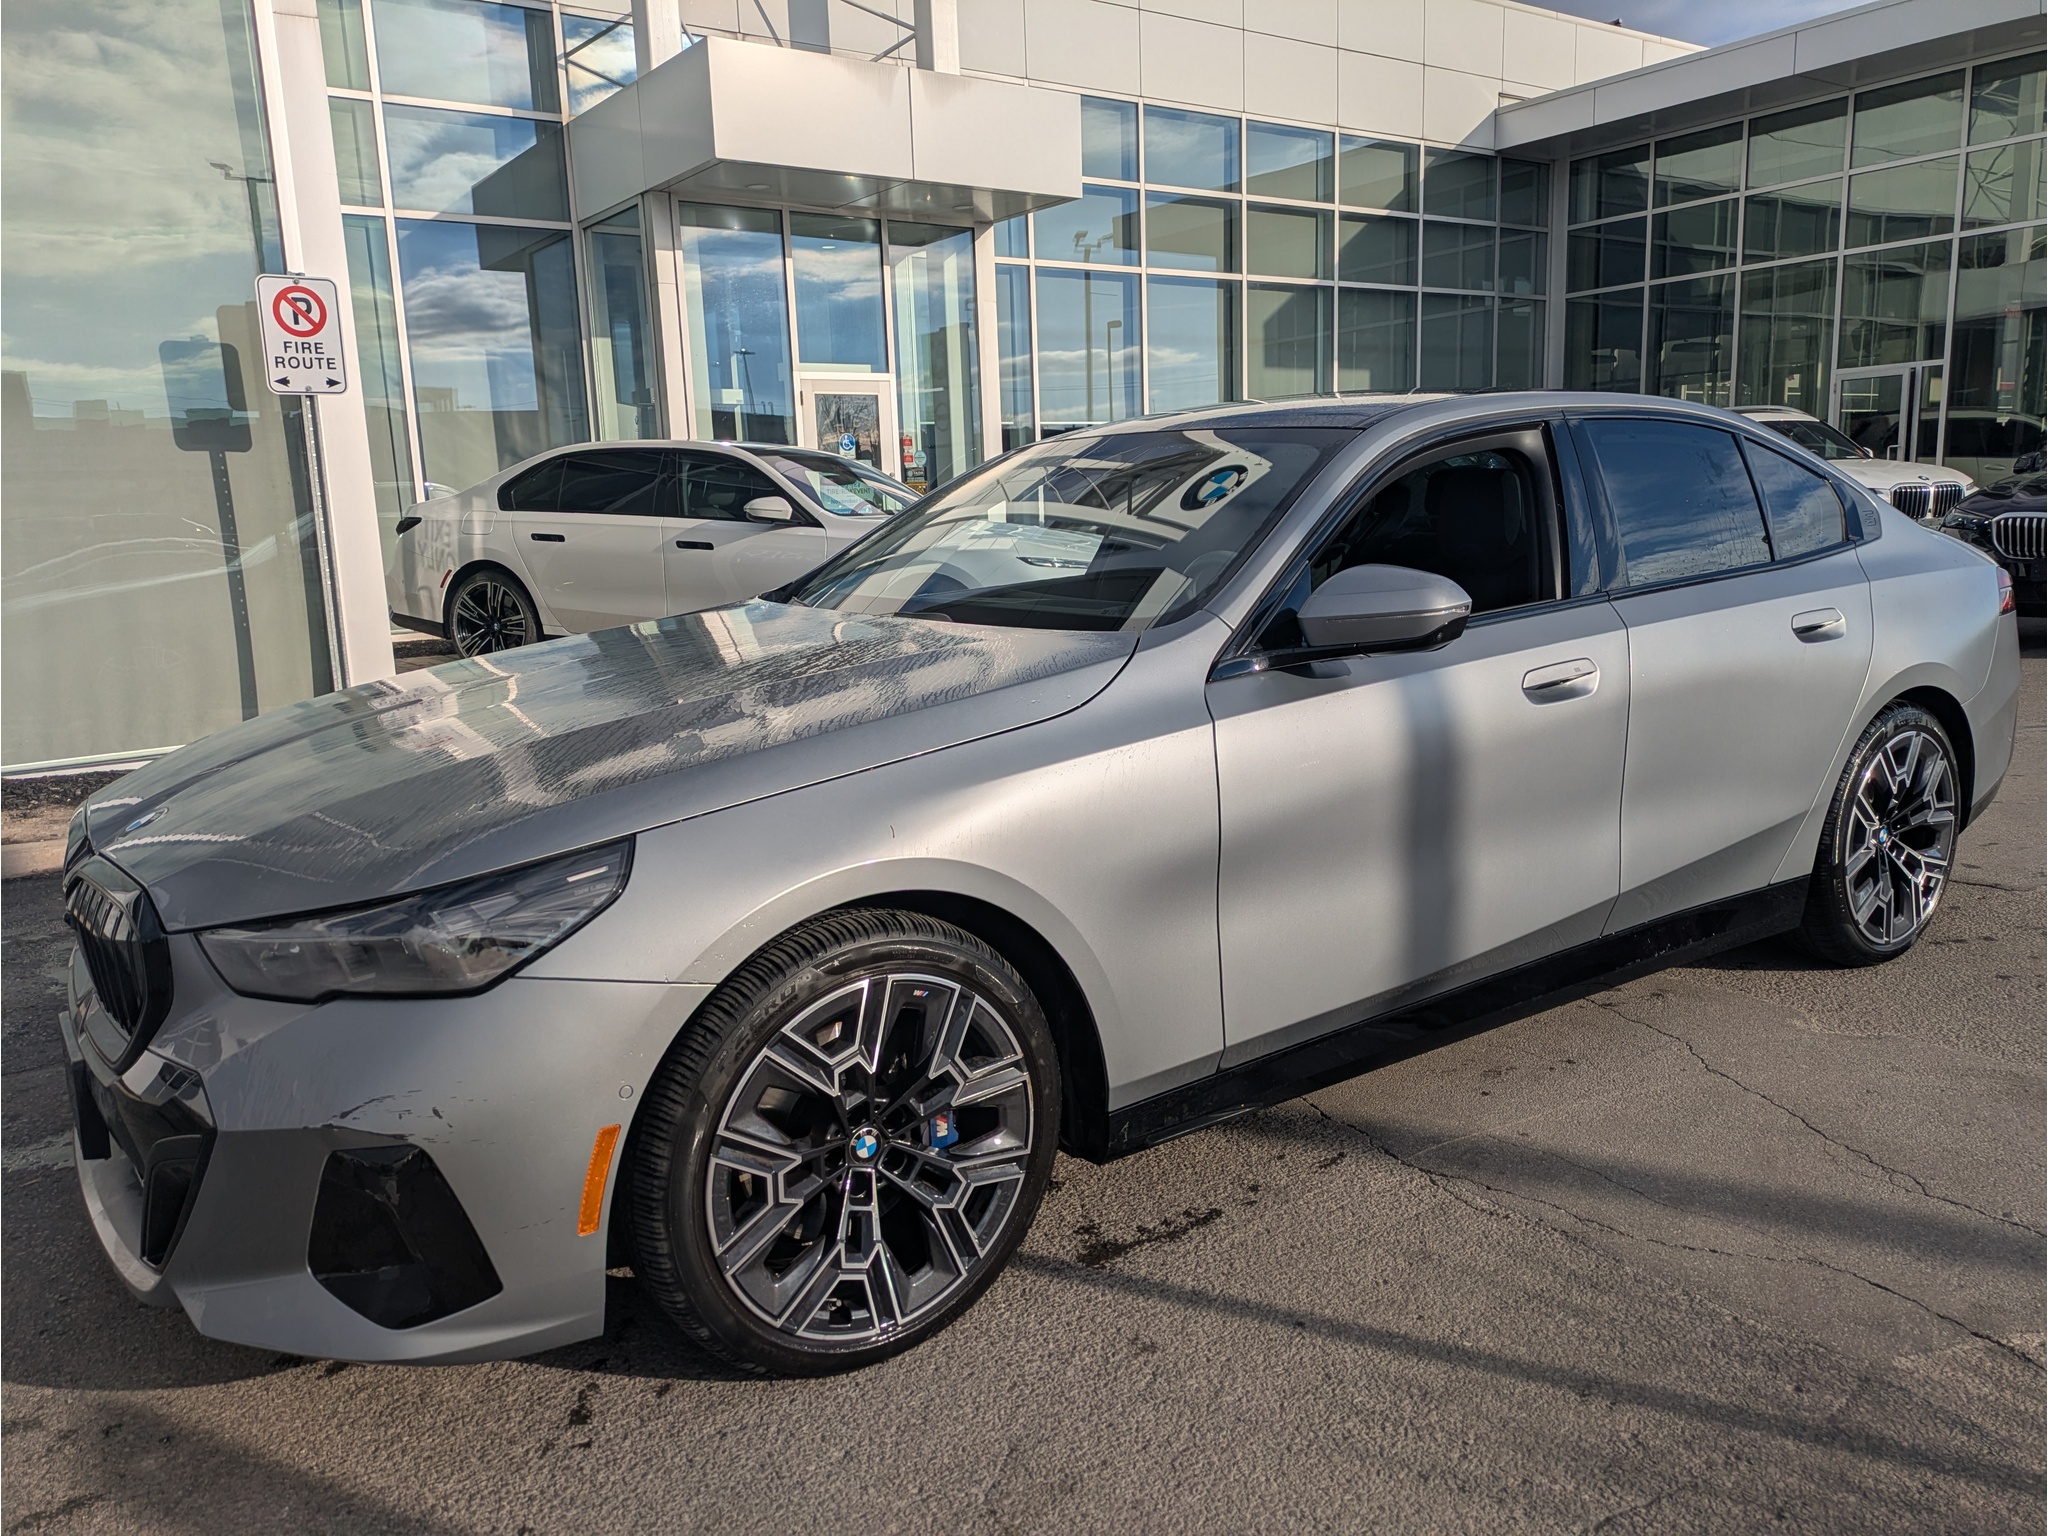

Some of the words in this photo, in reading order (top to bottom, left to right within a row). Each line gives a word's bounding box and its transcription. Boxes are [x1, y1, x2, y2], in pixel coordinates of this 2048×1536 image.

[283, 341, 325, 354] FIRE
[274, 356, 337, 370] ROUTE
[730, 979, 798, 1049] ZERO
